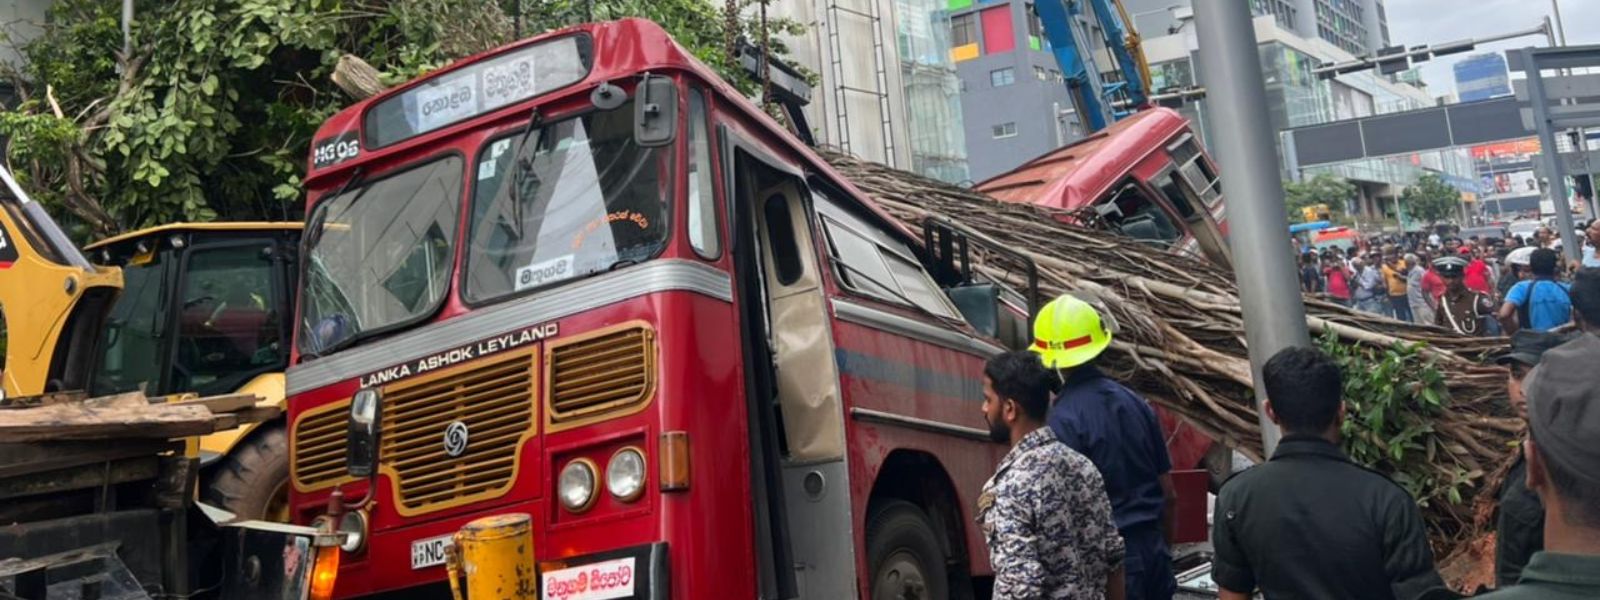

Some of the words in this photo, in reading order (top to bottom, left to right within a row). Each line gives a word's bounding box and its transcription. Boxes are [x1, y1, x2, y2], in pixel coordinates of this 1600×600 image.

[360, 367, 411, 388] LANKA
[417, 346, 473, 373] ASHOK
[478, 322, 559, 356] LEYLAND
